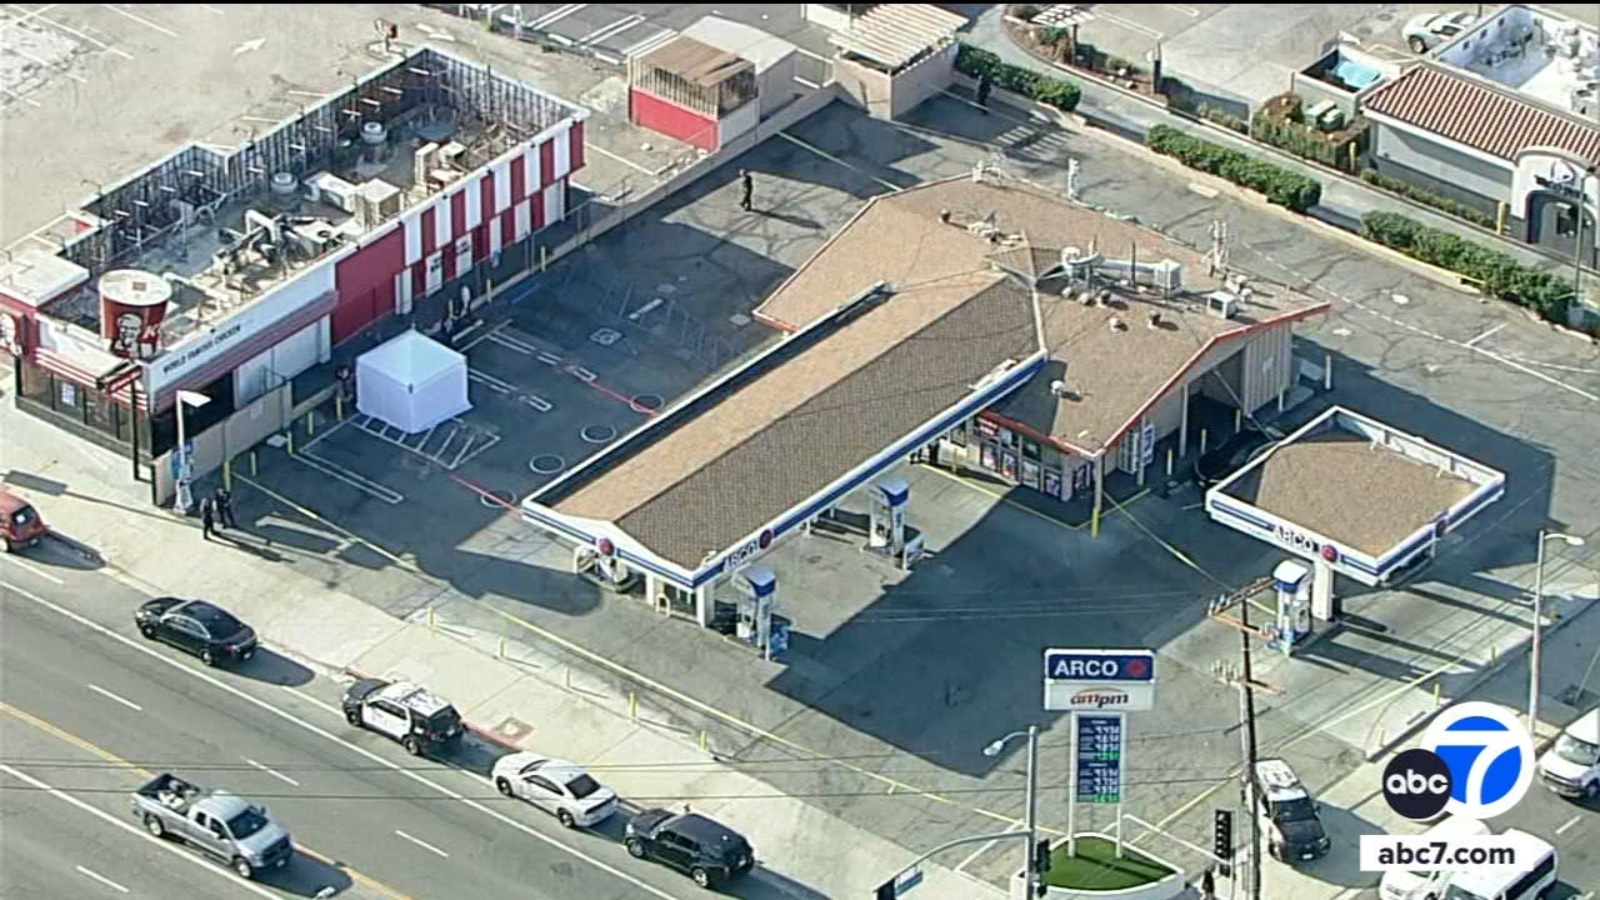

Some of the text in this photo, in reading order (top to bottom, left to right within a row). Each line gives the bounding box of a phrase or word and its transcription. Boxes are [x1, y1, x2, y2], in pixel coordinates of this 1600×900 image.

[1275, 525, 1313, 554] ARCO
[723, 540, 757, 572] ARCO
[1054, 660, 1119, 677] ARCO
[1070, 694, 1129, 708] ampm
